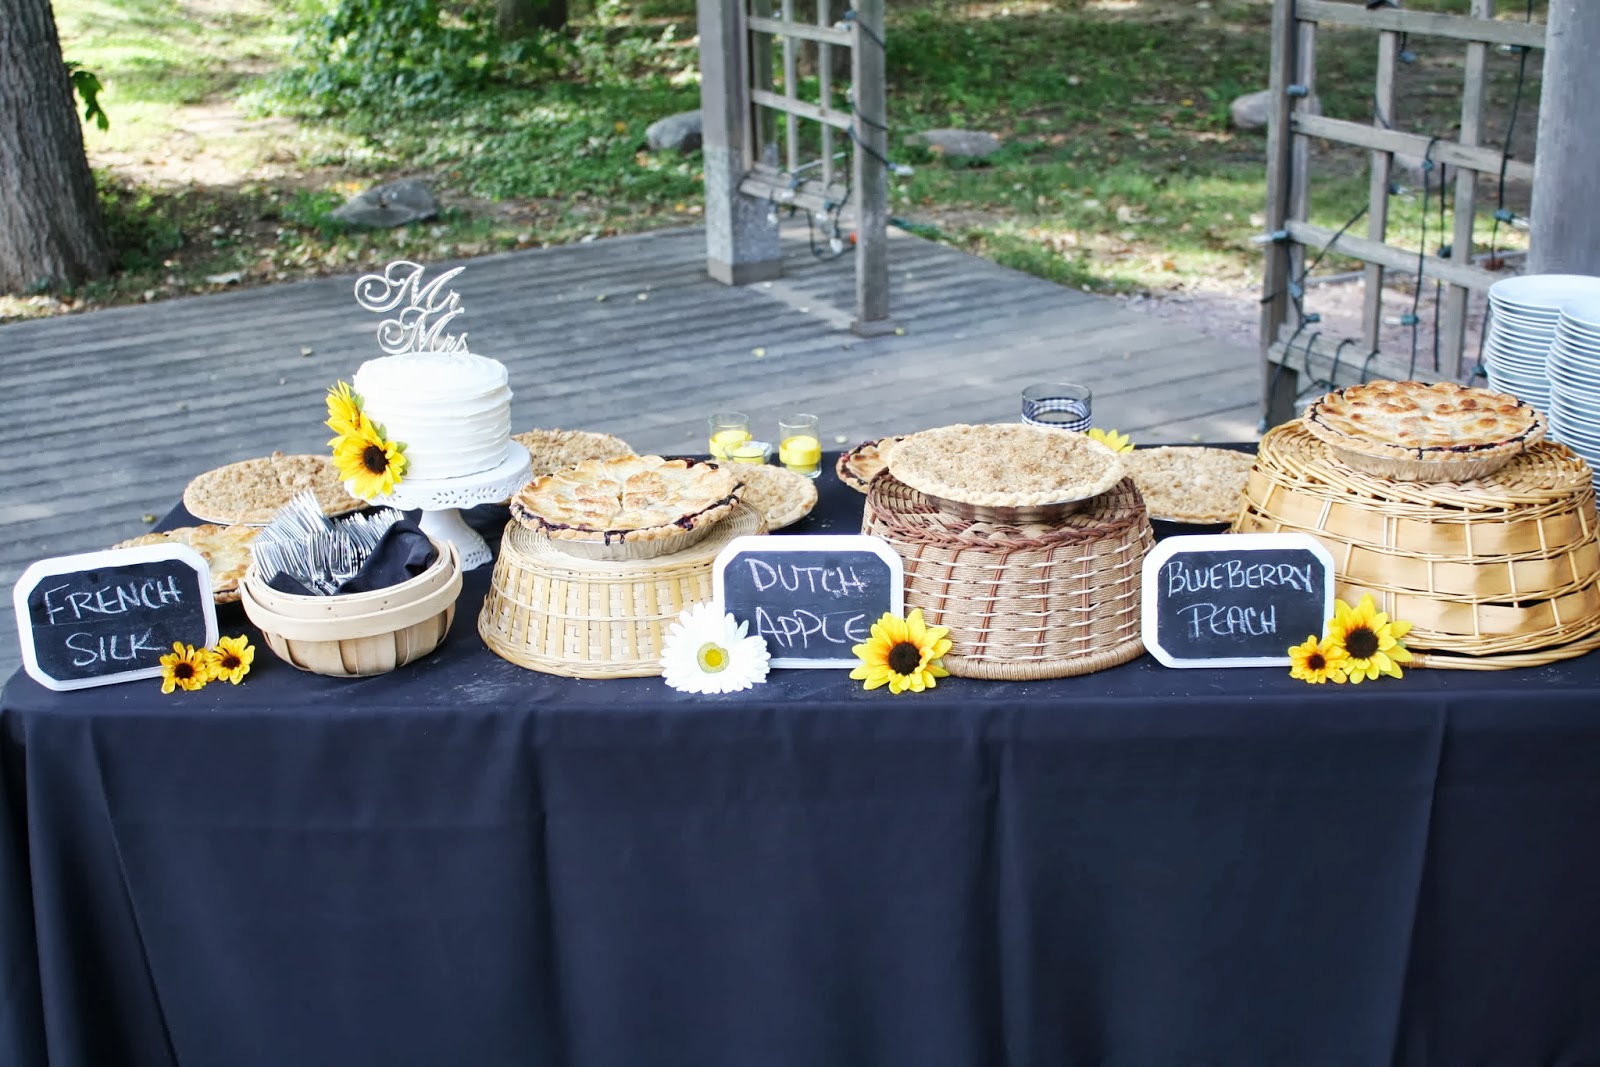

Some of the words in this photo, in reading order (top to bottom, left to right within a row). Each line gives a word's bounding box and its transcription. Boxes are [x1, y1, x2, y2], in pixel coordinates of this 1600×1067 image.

[354, 260, 466, 313] Mr
[377, 306, 469, 355] Mrs
[744, 558, 867, 596] DUTCH
[44, 575, 182, 625] FRENCH
[1176, 602, 1277, 638] PEACH
[65, 627, 167, 667] SILK
[755, 606, 870, 649] APPLE
